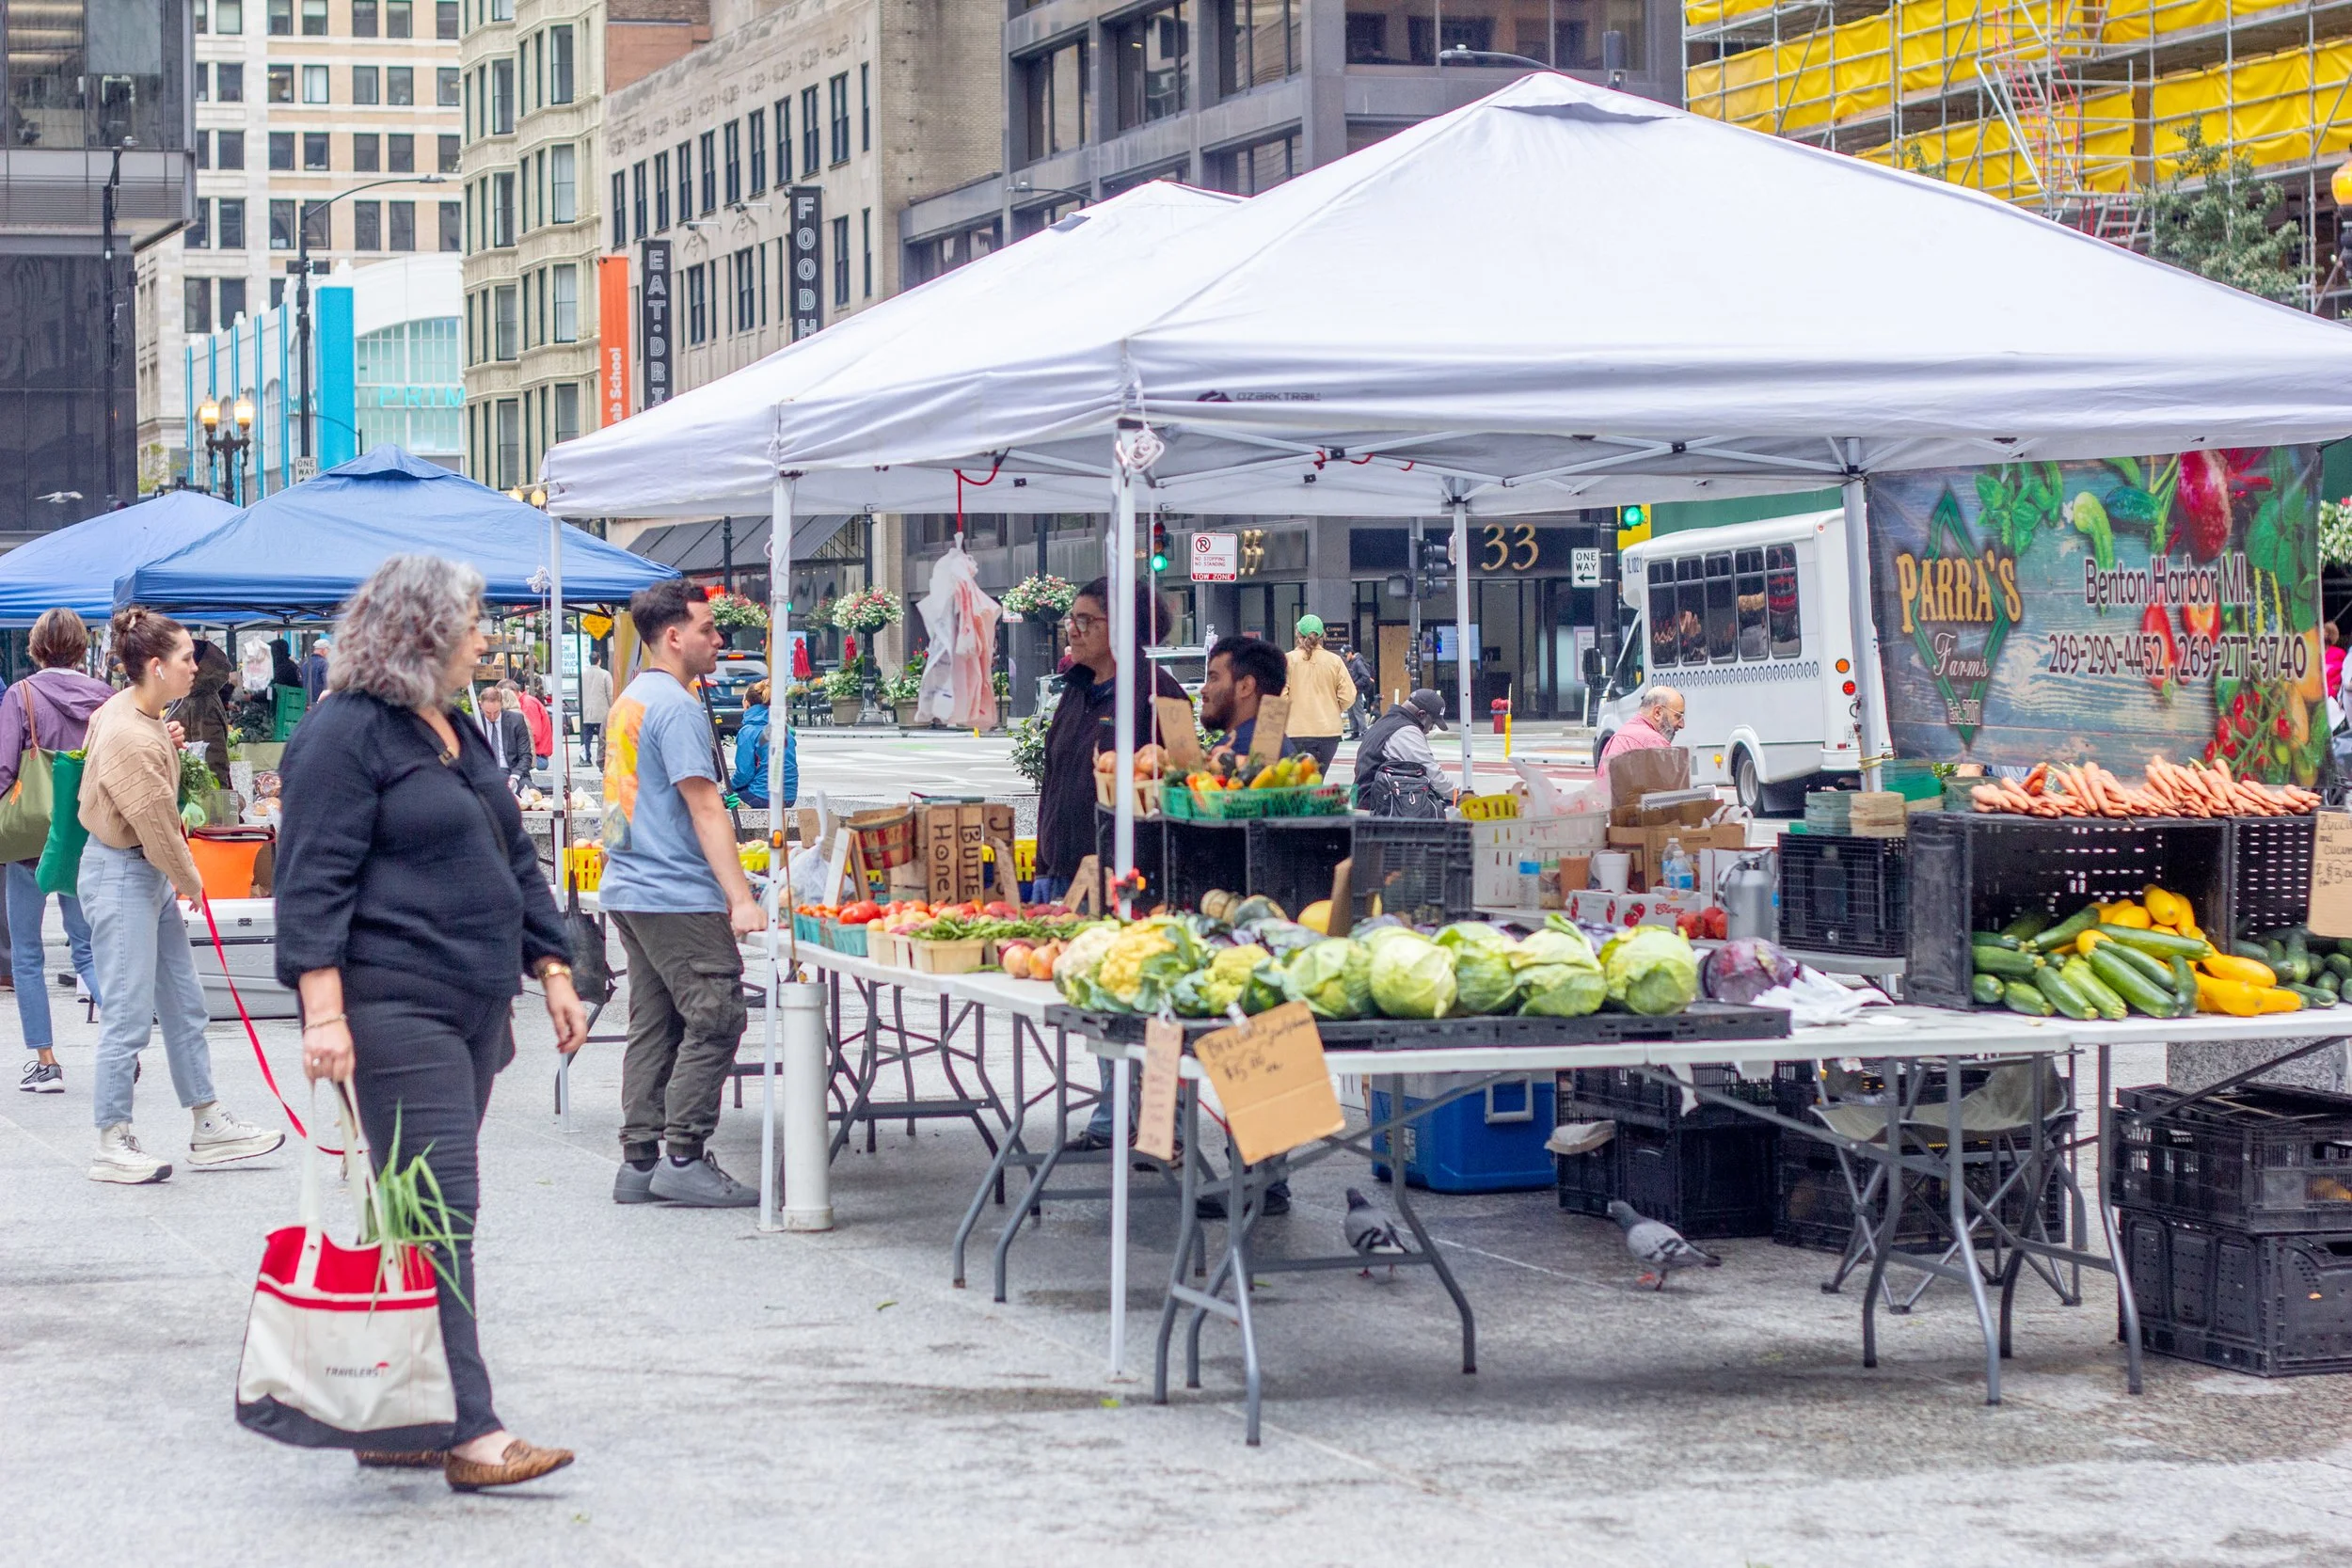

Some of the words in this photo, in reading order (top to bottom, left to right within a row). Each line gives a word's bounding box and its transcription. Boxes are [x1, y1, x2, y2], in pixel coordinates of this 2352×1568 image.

[609, 347, 623, 400] School
[1480, 522, 1540, 572] 33
[1575, 552, 1597, 562] ONE
[1575, 562, 1597, 572] WAY
[1896, 549, 2022, 634] PARRA'S
[2085, 558, 2148, 605] Benton
[2151, 554, 2217, 605] Harbor
[1933, 632, 1990, 677] Farms
[2048, 633, 2165, 675] 269-290-4452
[2178, 634, 2307, 679] 269-277-9740
[932, 824, 952, 904] Hone
[961, 825, 981, 904] BUTTE
[325, 1366, 378, 1377] TRAVELERS
